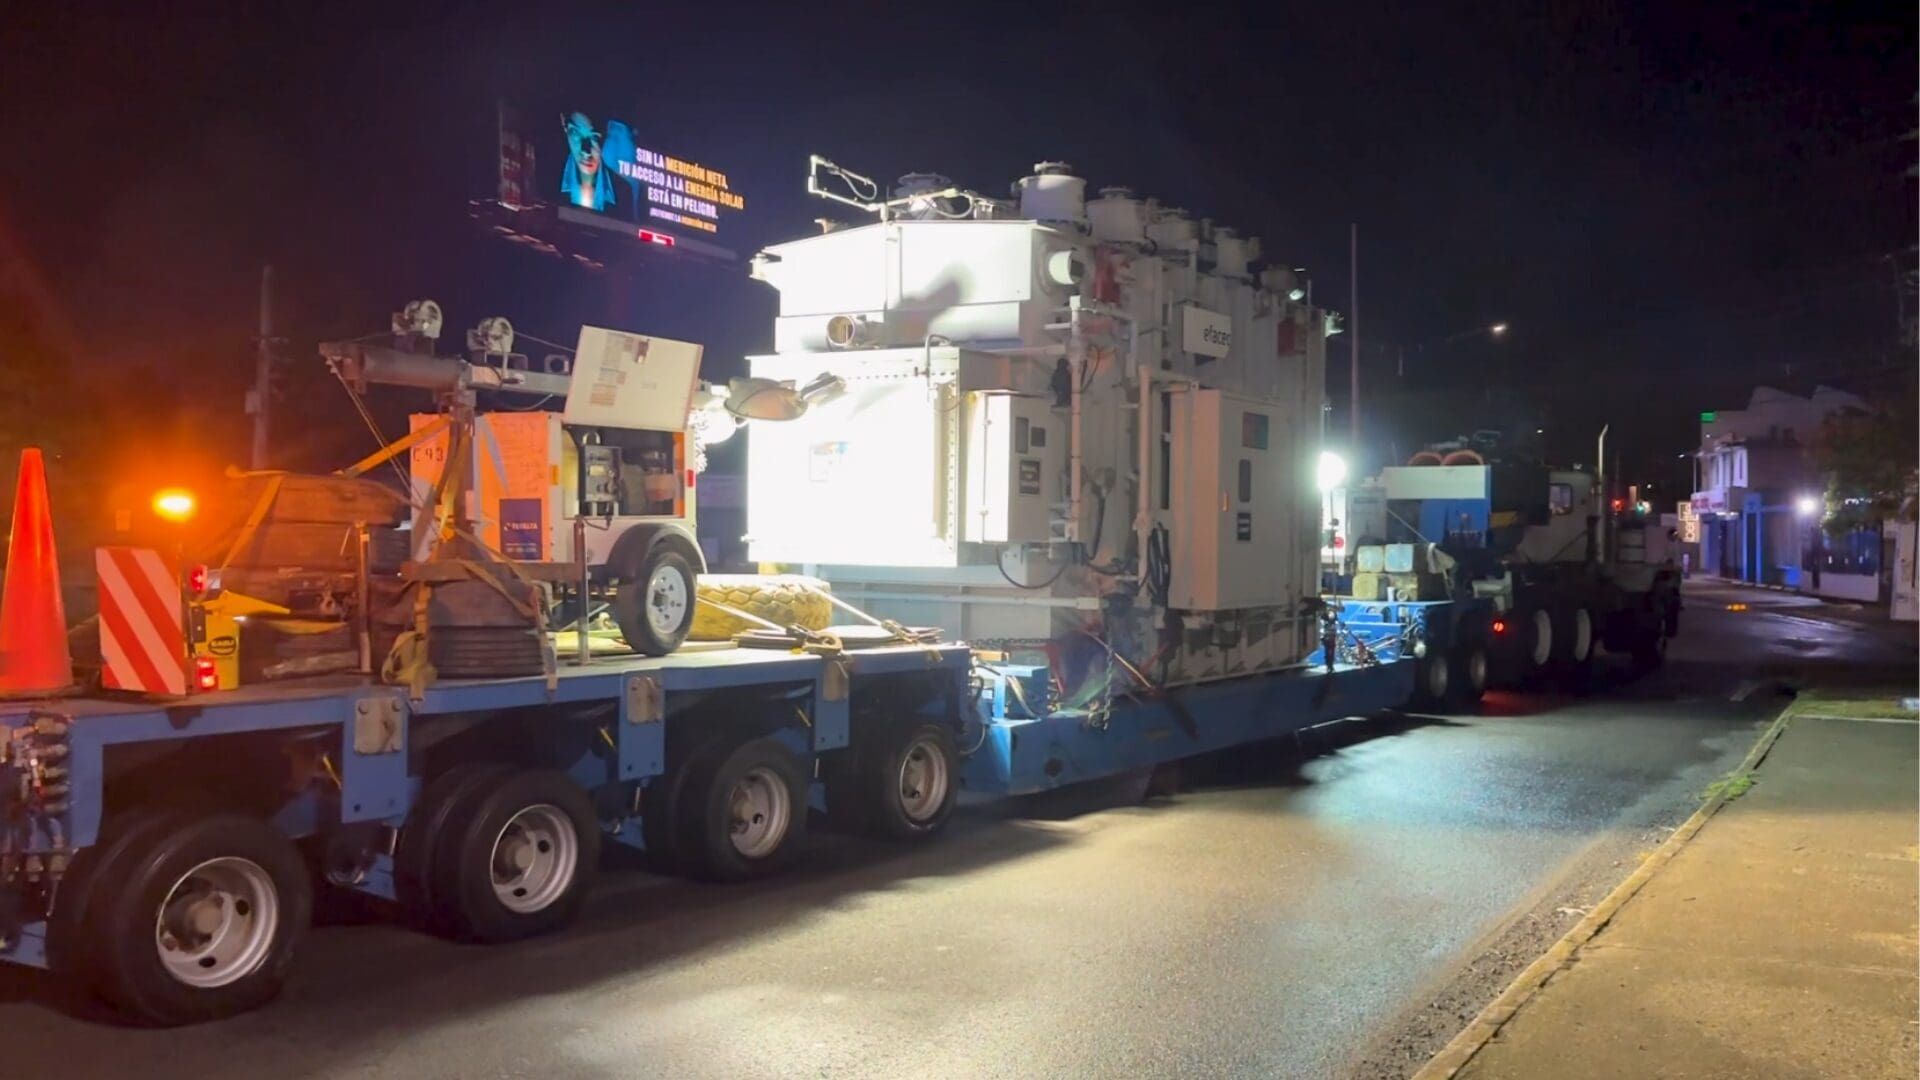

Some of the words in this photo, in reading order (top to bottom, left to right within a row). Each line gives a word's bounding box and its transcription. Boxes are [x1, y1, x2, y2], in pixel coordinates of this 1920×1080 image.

[636, 147, 653, 165] SIN
[653, 152, 664, 168] LA
[665, 156, 705, 181] MEDICIÓN
[618, 159, 631, 177] TU
[631, 164, 665, 186] ACCESO
[666, 174, 673, 189] A
[673, 176, 684, 193] LA
[685, 179, 719, 202] ENERGÍA
[719, 190, 743, 210] SOLAR
[648, 186, 670, 206] ESTÁ
[670, 193, 683, 210] EN
[684, 196, 719, 219] PELIGRO.
[1203, 323, 1231, 346] efacec
